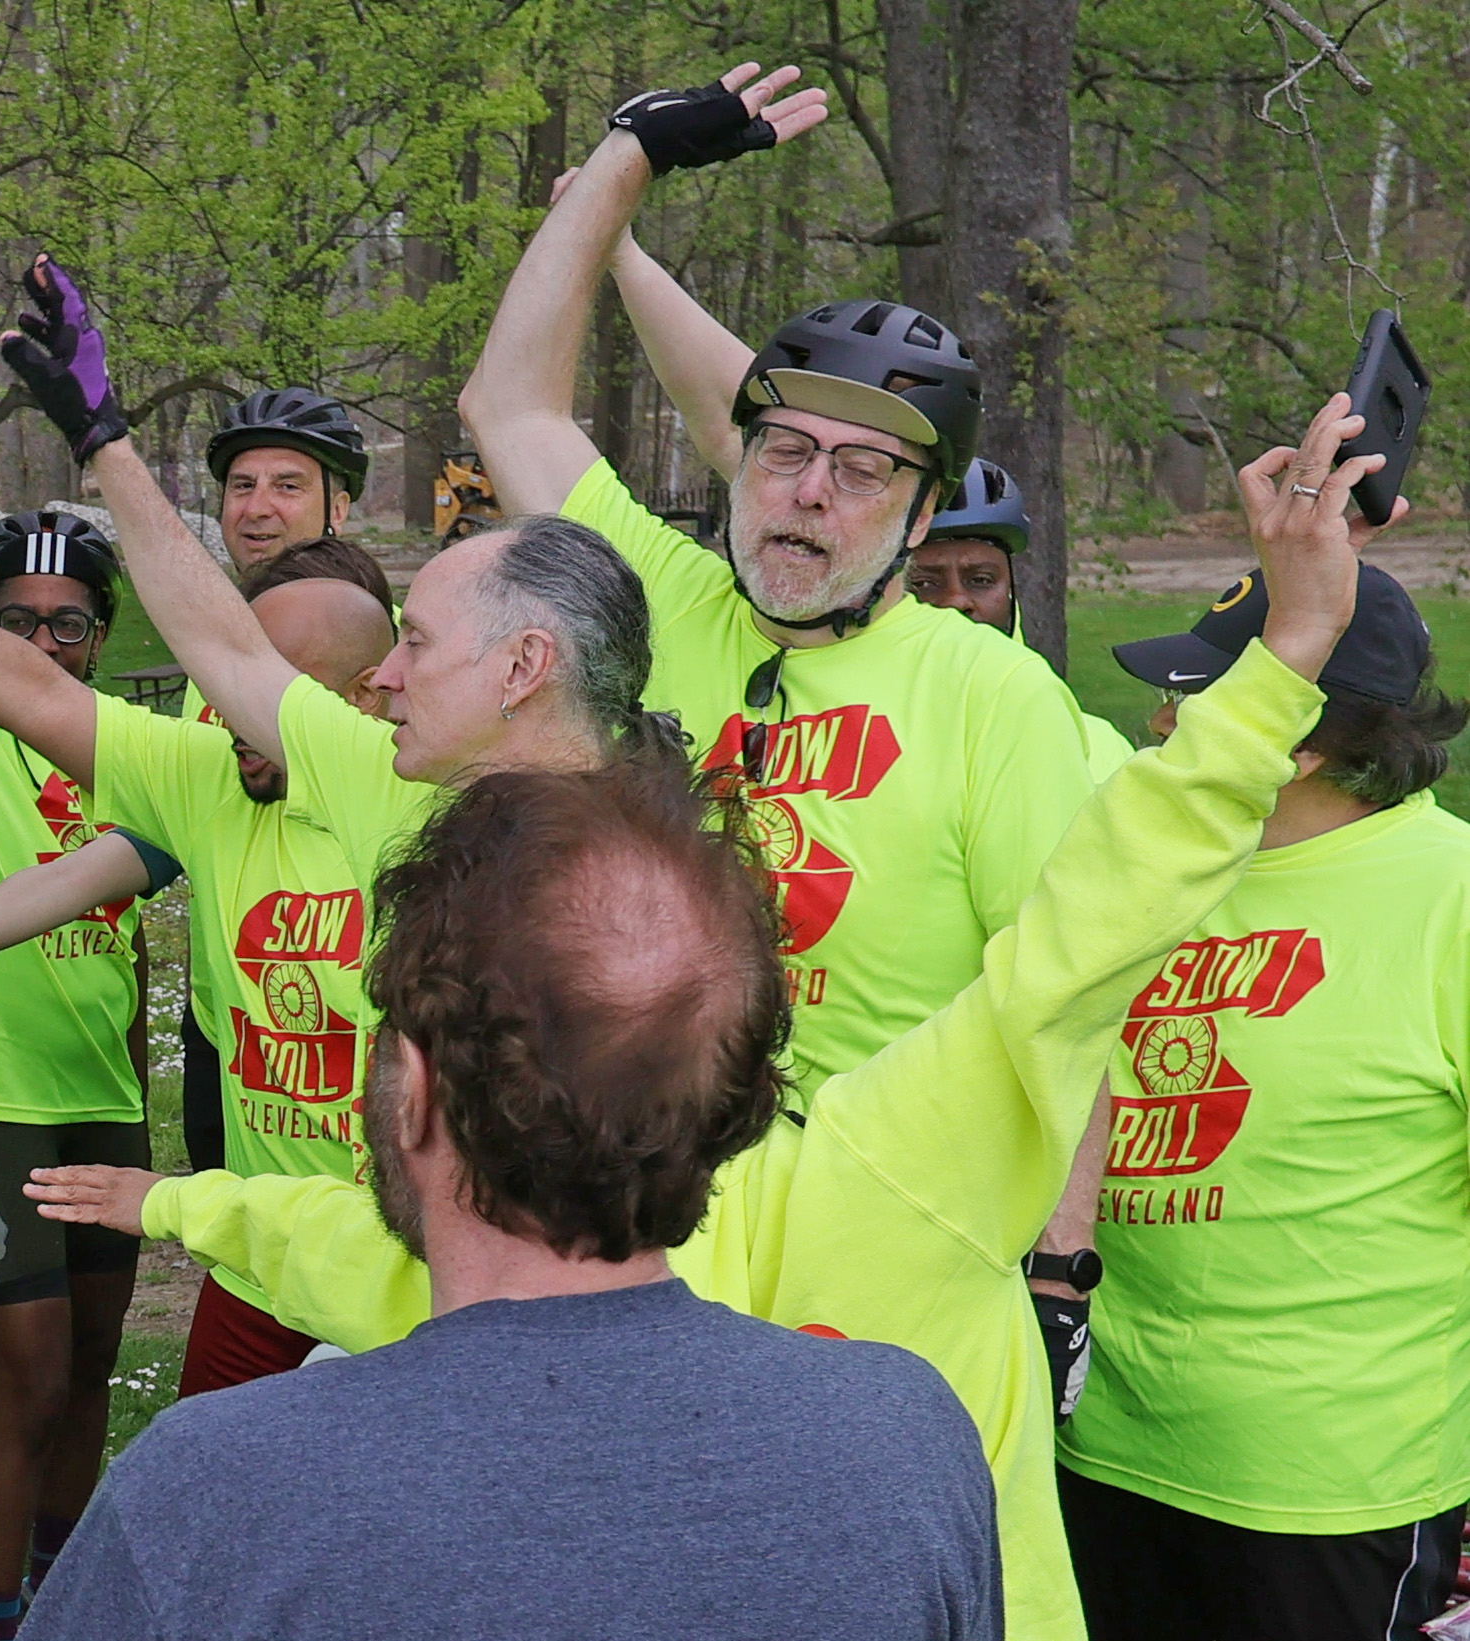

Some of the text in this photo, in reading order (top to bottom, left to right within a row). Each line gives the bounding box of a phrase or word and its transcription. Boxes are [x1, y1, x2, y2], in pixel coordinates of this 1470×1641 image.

[1147, 936, 1280, 1008] SLOW
[260, 1034, 339, 1097] ROLL
[240, 1098, 351, 1143] CLEVELAN
[1110, 1102, 1201, 1168] ROLL
[1097, 1186, 1224, 1225] EVELAND
